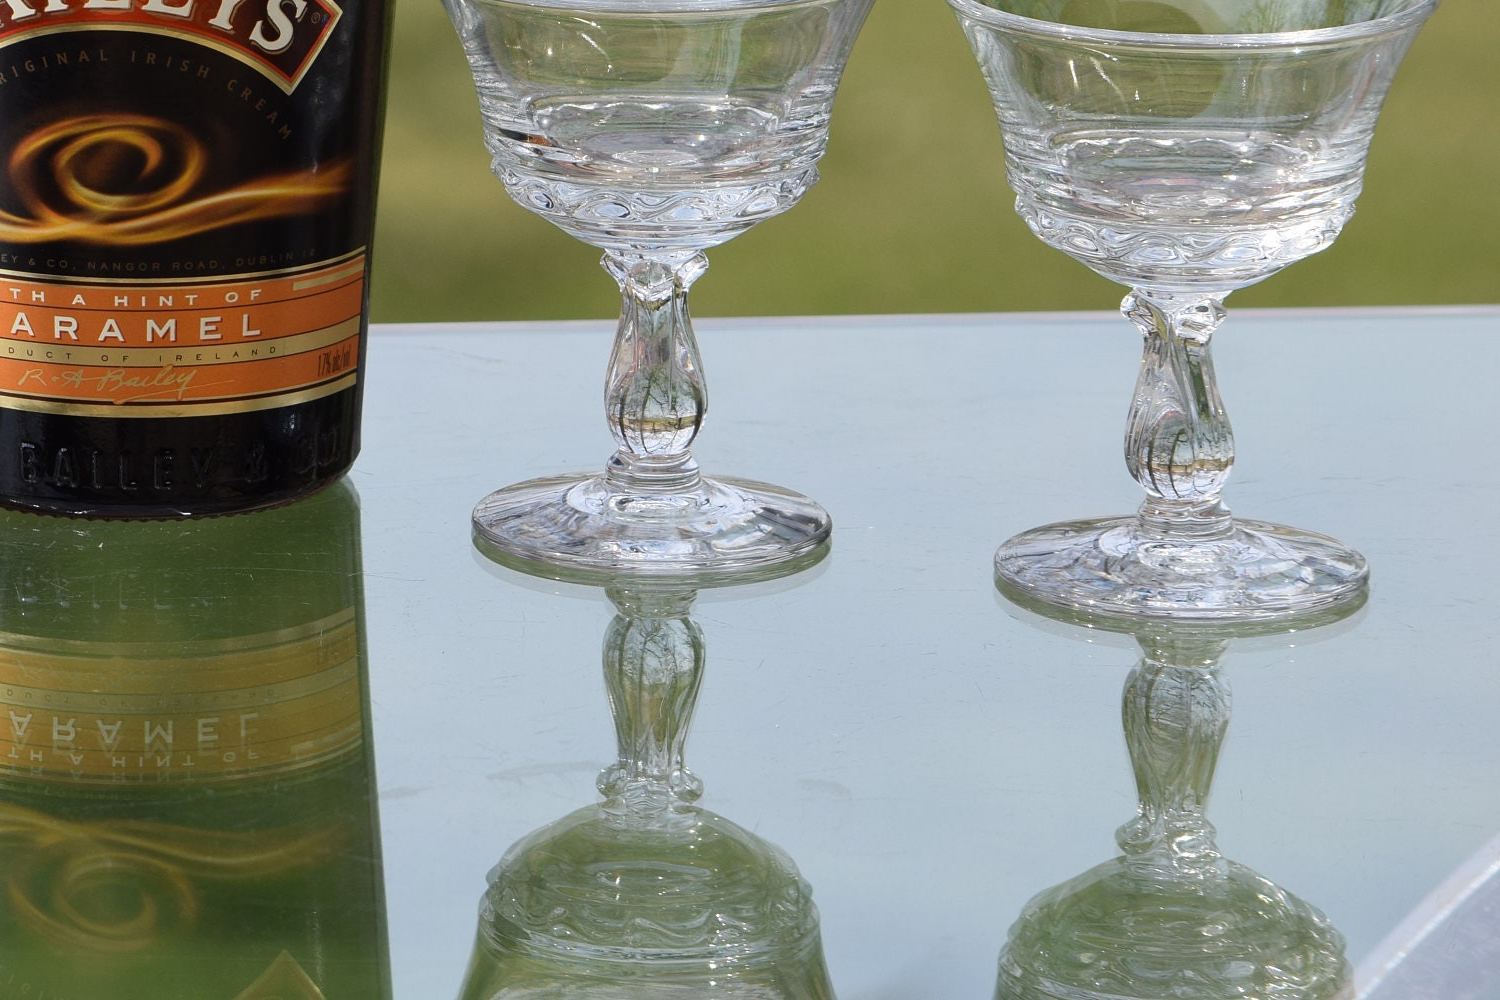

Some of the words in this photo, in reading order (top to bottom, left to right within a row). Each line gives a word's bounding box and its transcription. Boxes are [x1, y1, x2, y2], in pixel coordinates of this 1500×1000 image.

[130, 50, 210, 79] IRISH
[227, 79, 293, 140] CREAM
[87, 261, 162, 272] NANGOR
[235, 251, 294, 268] DUBLIN
[71, 293, 87, 306] A
[114, 294, 199, 307] HINT
[224, 288, 263, 304] OF
[100, 355, 130, 363] OF
[159, 346, 277, 362] IRELAND
